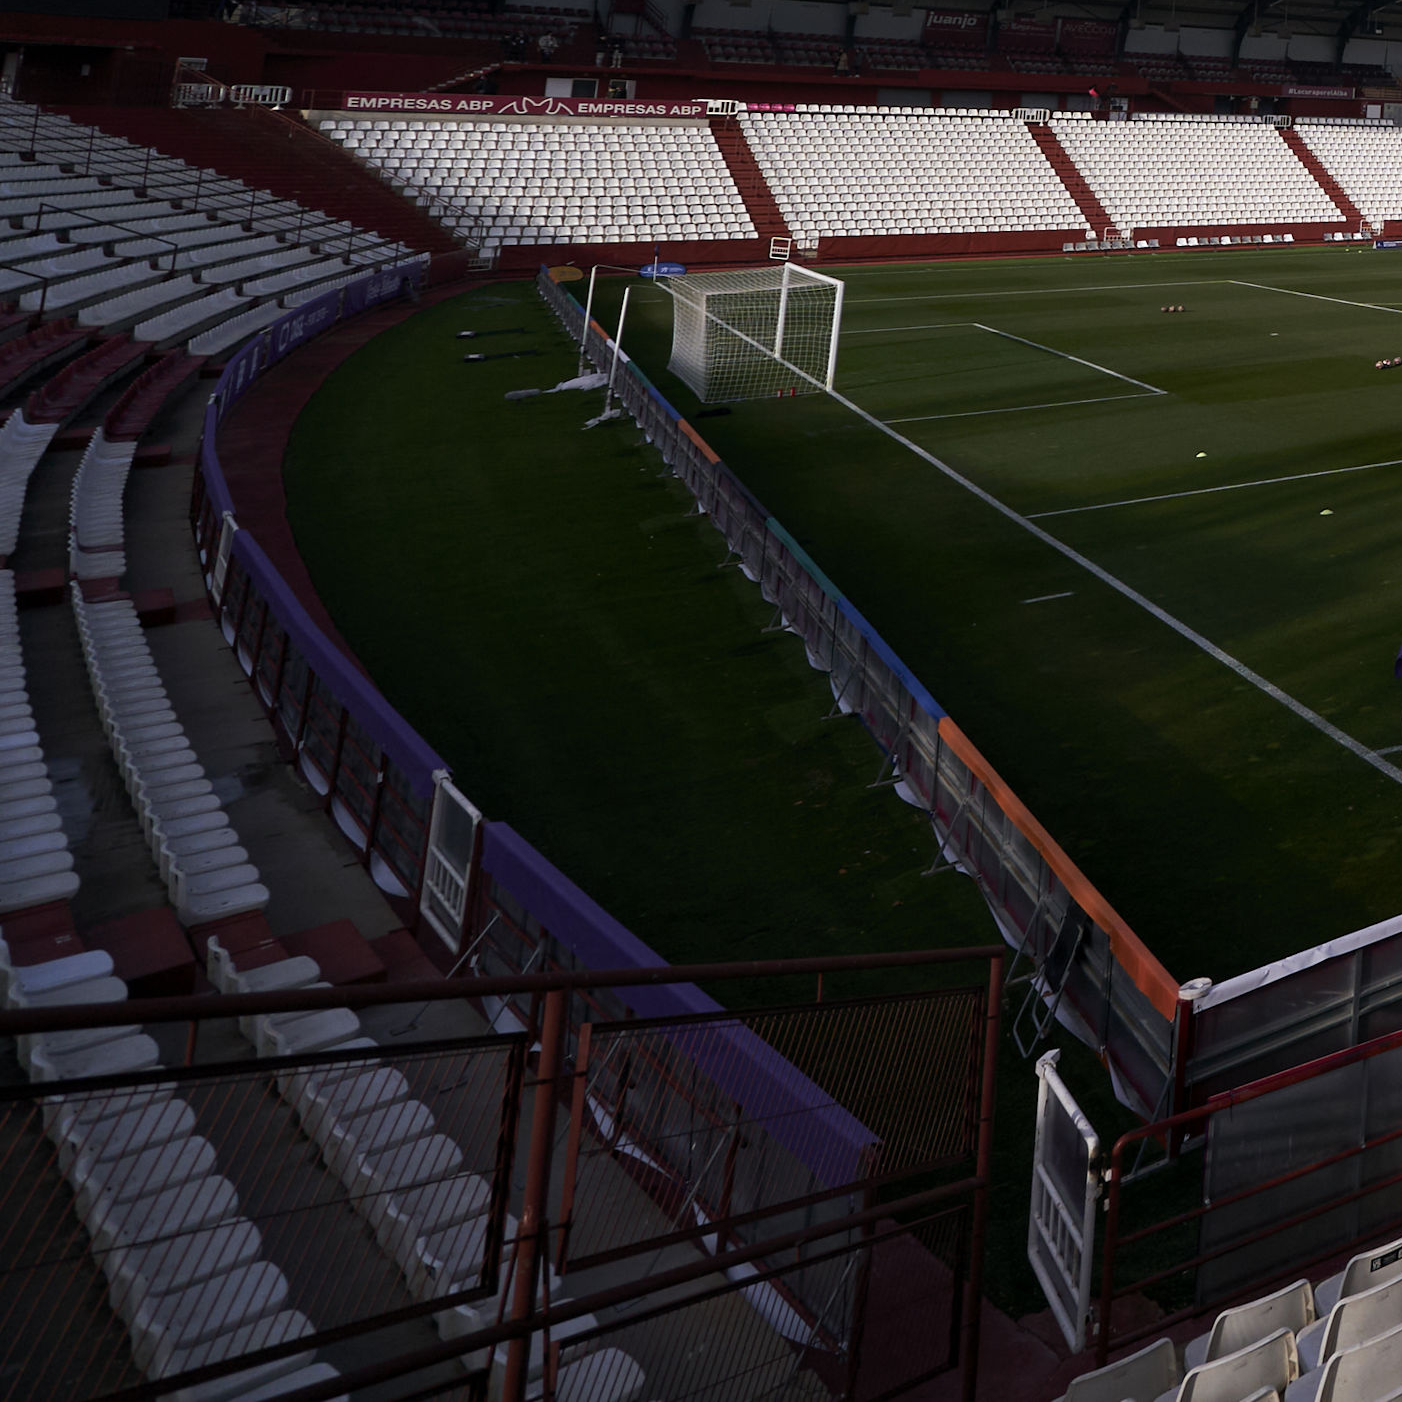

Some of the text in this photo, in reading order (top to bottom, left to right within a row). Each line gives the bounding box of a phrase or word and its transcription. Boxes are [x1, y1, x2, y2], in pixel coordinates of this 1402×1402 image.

[927, 11, 977, 29] juanjo
[347, 96, 494, 111] EMPRESAS ABP
[577, 102, 702, 116] EMPRESAS ABP
